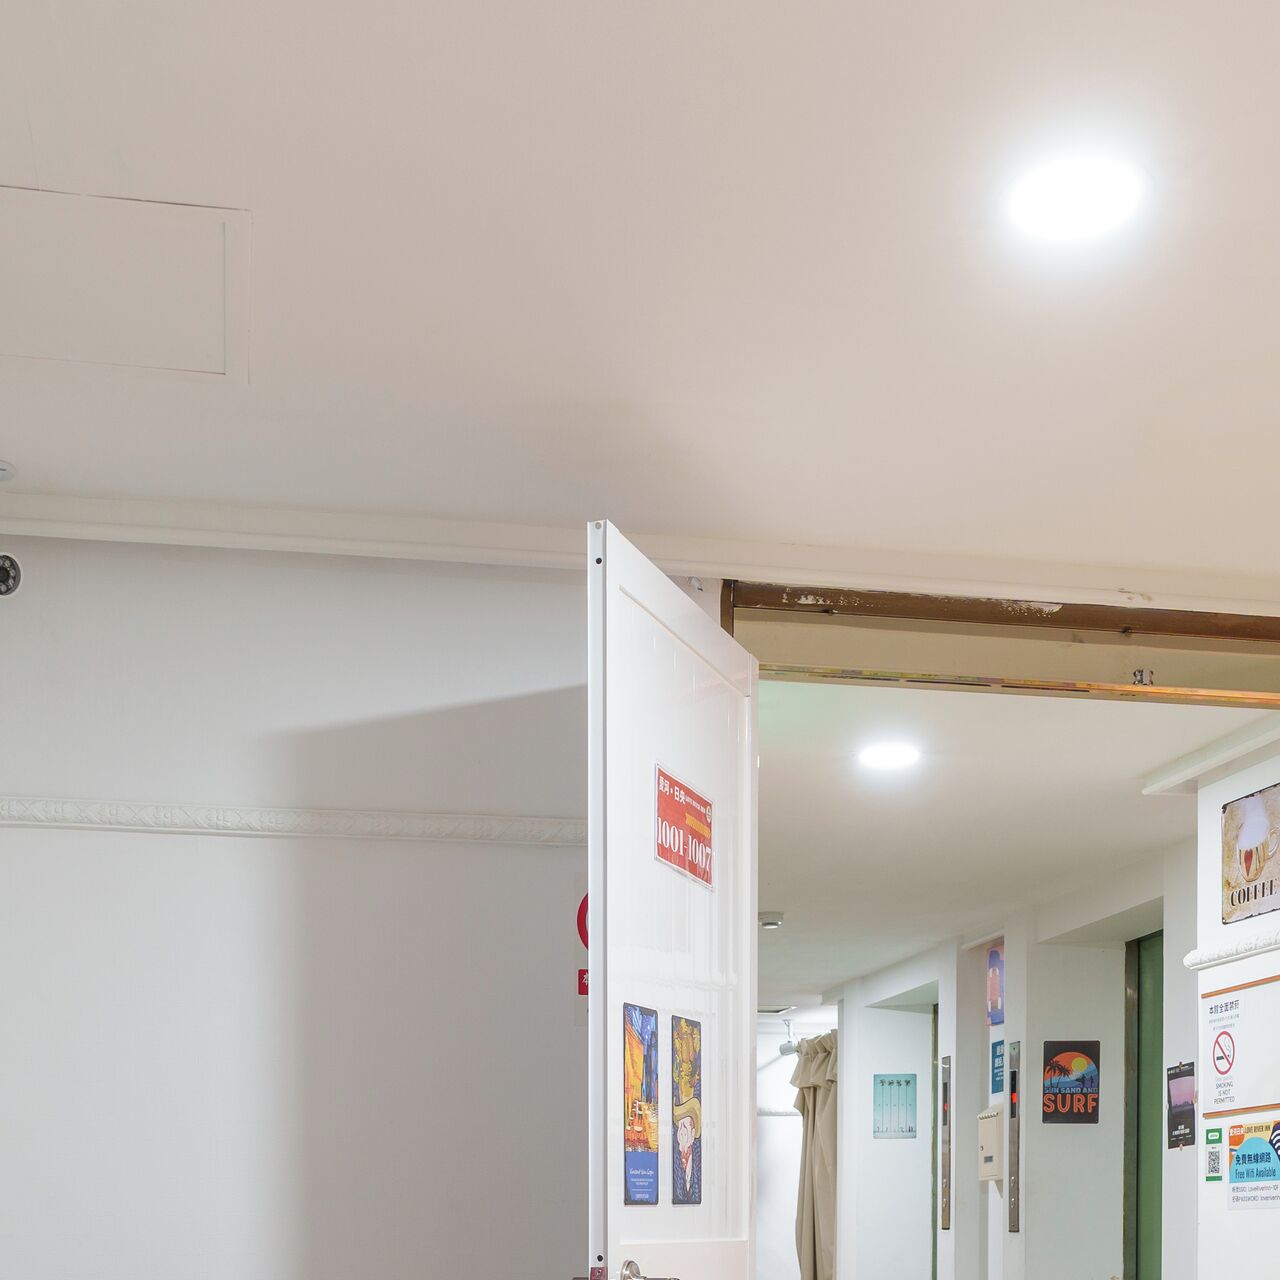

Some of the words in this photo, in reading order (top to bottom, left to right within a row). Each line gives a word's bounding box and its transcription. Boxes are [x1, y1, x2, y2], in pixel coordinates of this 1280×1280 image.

[656, 816, 712, 872] 1001-1007
[1230, 878, 1280, 907] COFFEE
[1043, 1093, 1099, 1113] SURF
[1235, 1168, 1245, 1179] Free
